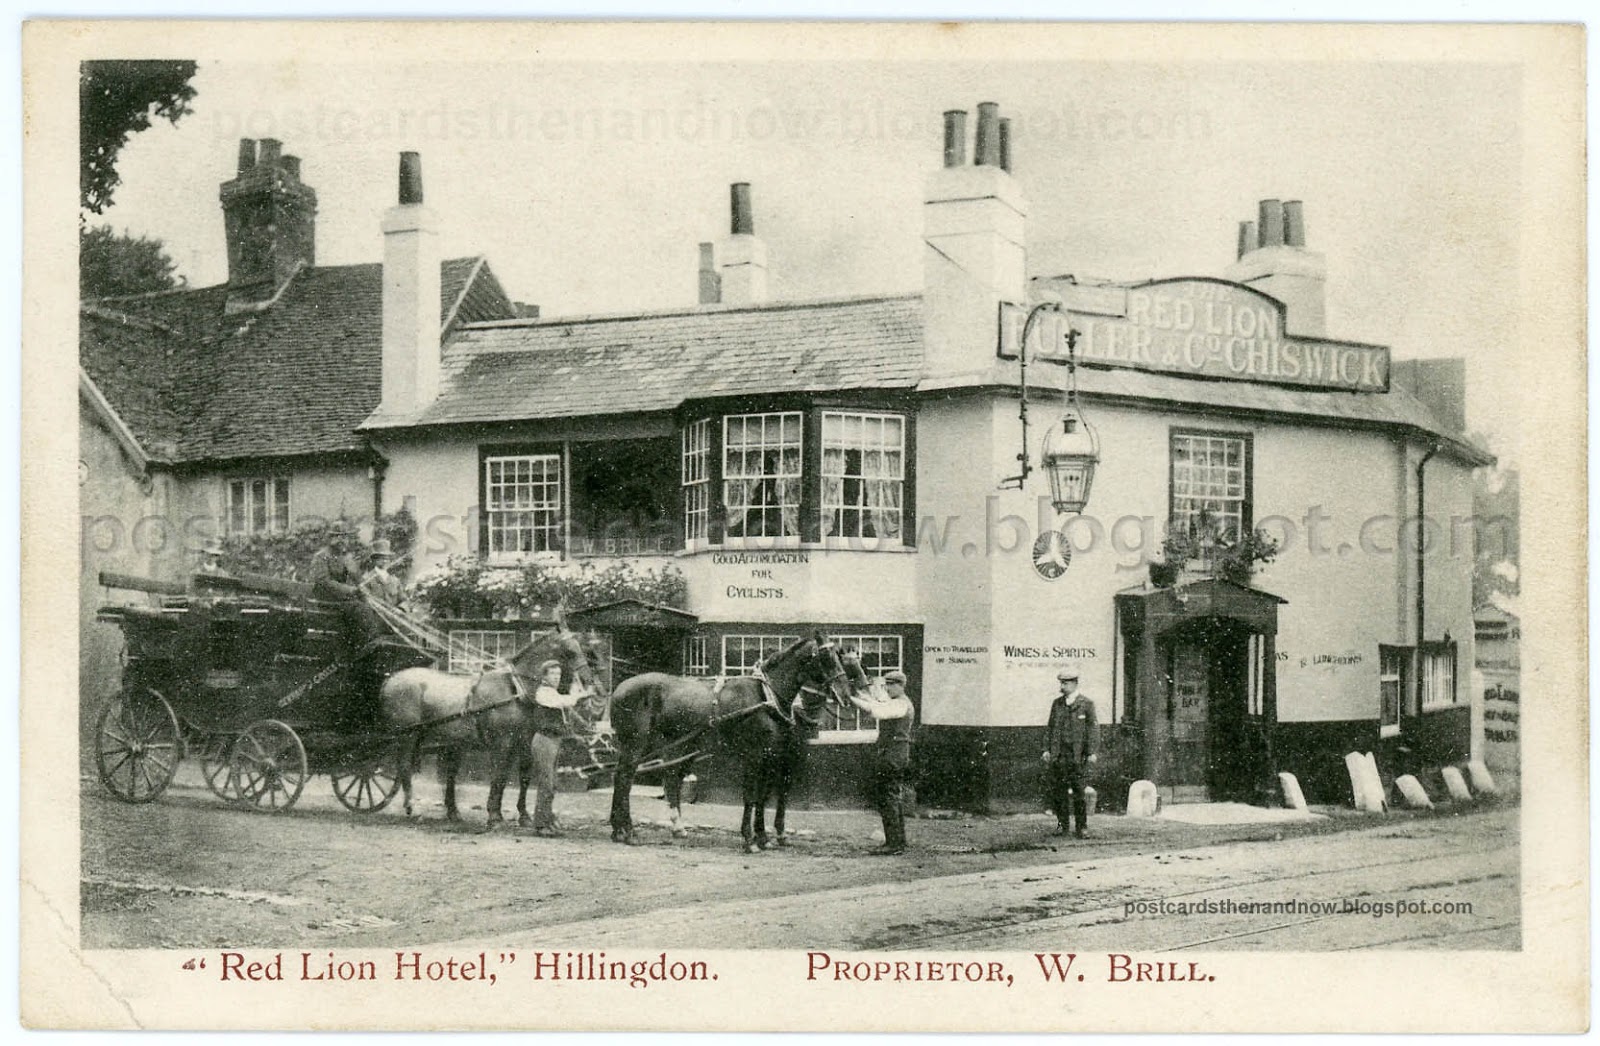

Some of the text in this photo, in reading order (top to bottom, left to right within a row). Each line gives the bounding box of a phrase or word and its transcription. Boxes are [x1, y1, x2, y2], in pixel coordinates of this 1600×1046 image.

[1129, 293, 1279, 340] RED LION
[1162, 346, 1177, 366] &
[1227, 336, 1385, 387] CHISWICK
[1003, 645, 1041, 658] WINES
